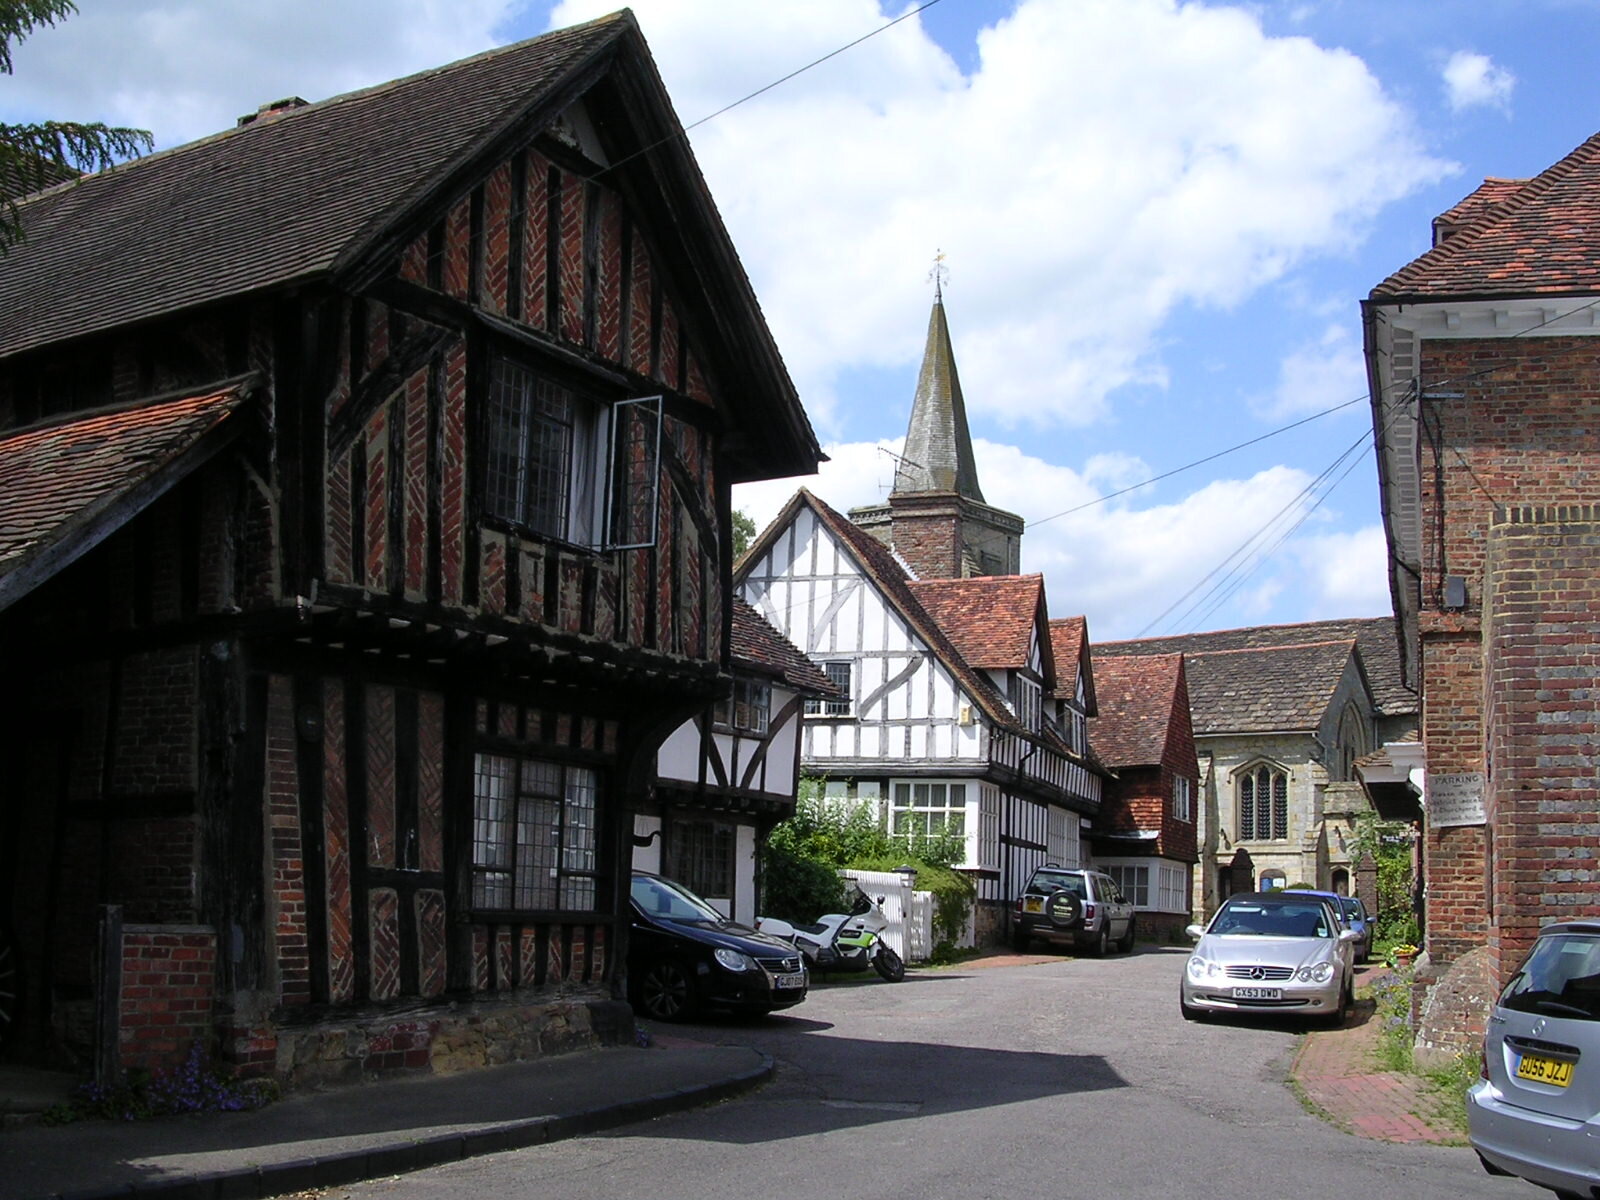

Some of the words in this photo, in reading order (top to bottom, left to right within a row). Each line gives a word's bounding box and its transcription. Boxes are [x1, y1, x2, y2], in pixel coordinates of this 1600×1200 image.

[1434, 774, 1479, 785] PARKING
[1235, 987, 1259, 998] GX53
[1519, 1055, 1546, 1077] GU56
[1546, 1061, 1571, 1082] JZJ
